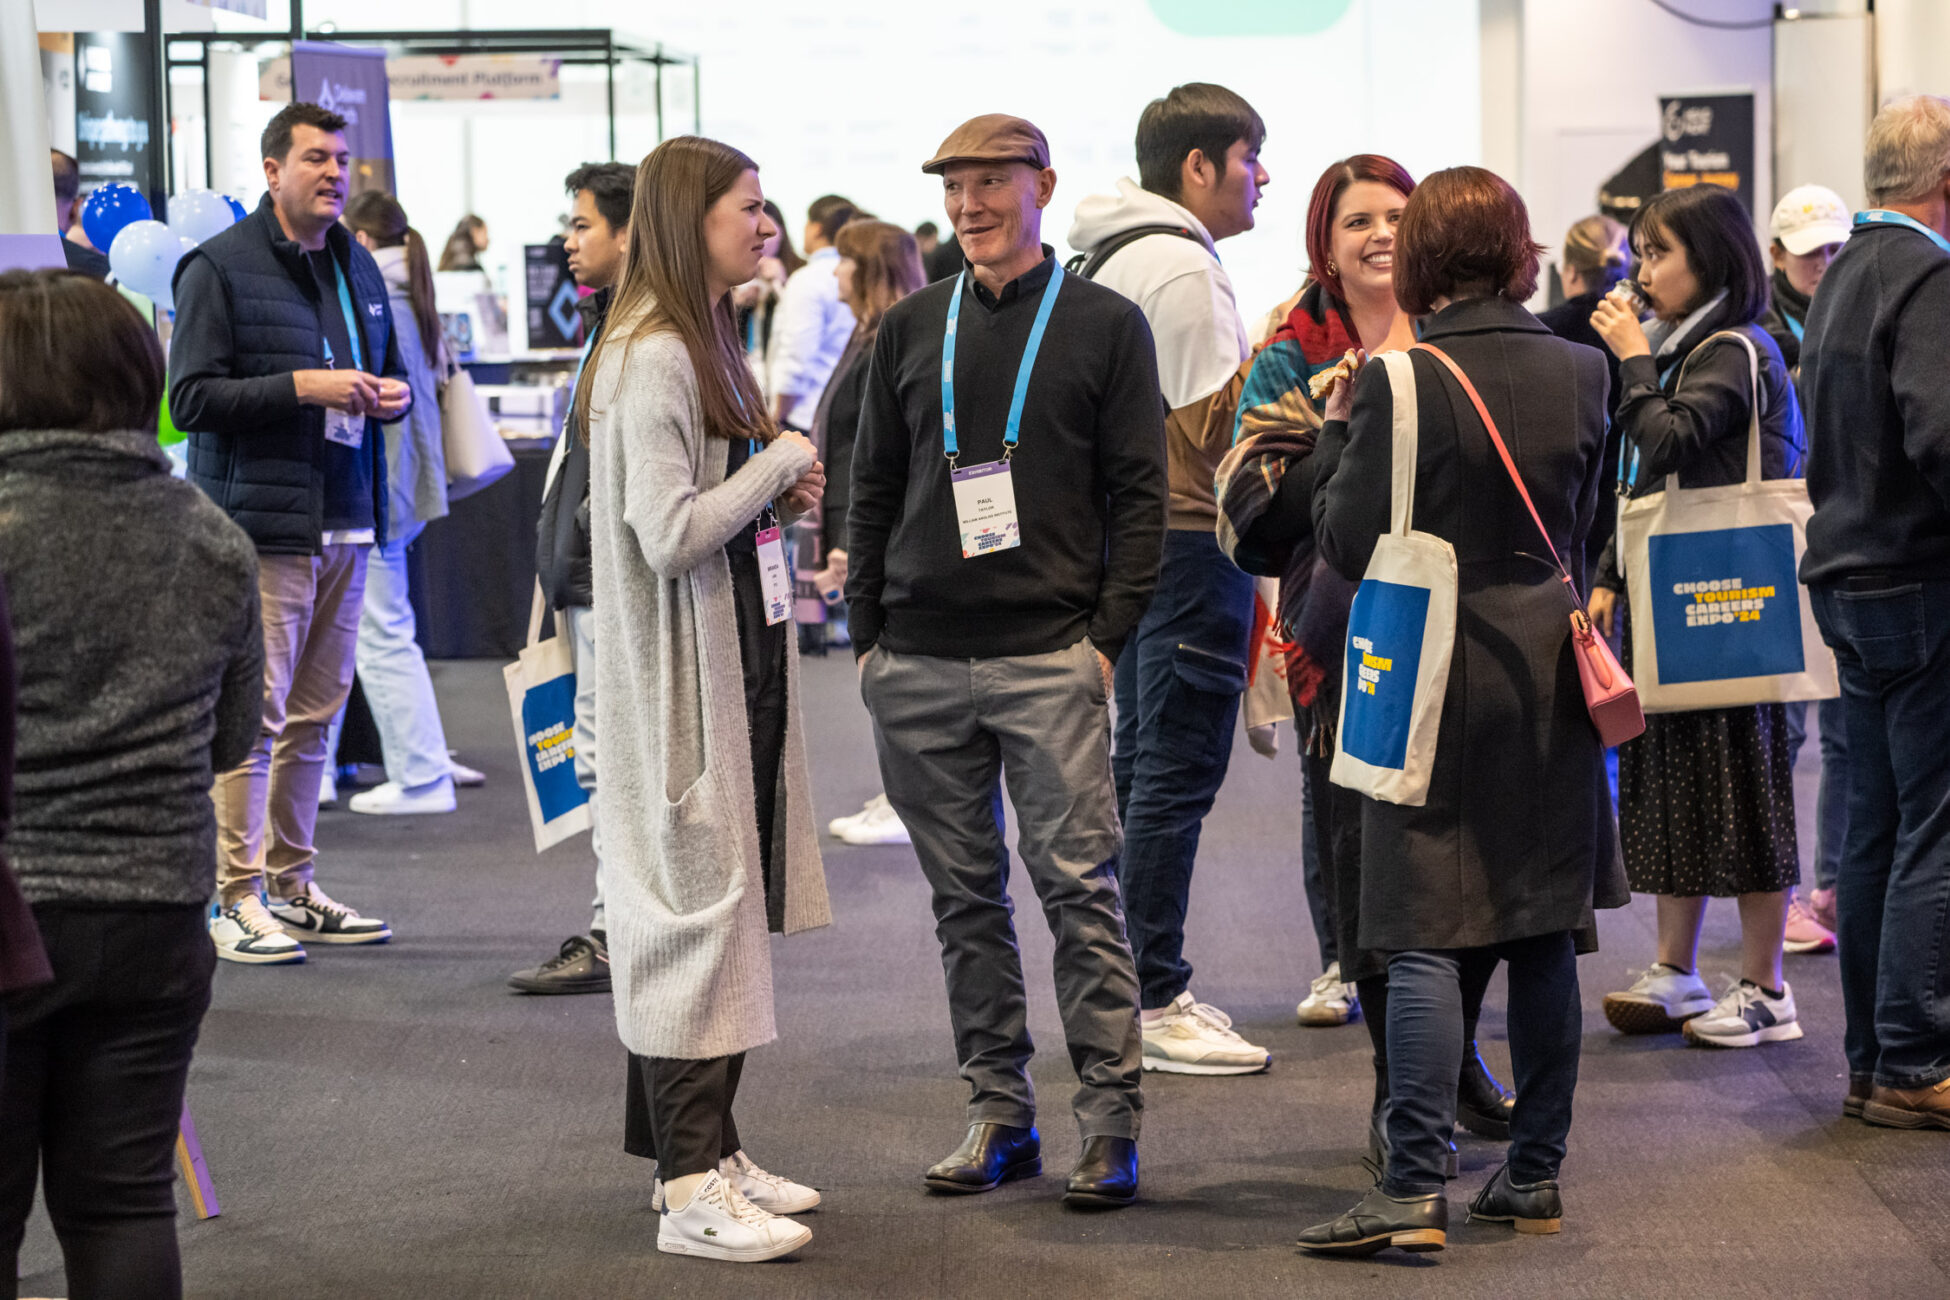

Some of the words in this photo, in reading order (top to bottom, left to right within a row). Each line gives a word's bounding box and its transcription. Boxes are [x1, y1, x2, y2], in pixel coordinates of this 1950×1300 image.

[1673, 578, 1742, 595] CHOOSE
[1694, 586, 1775, 604] TOURISM
[1685, 598, 1764, 616] CAREERS
[1686, 610, 1760, 627] EXPO'24
